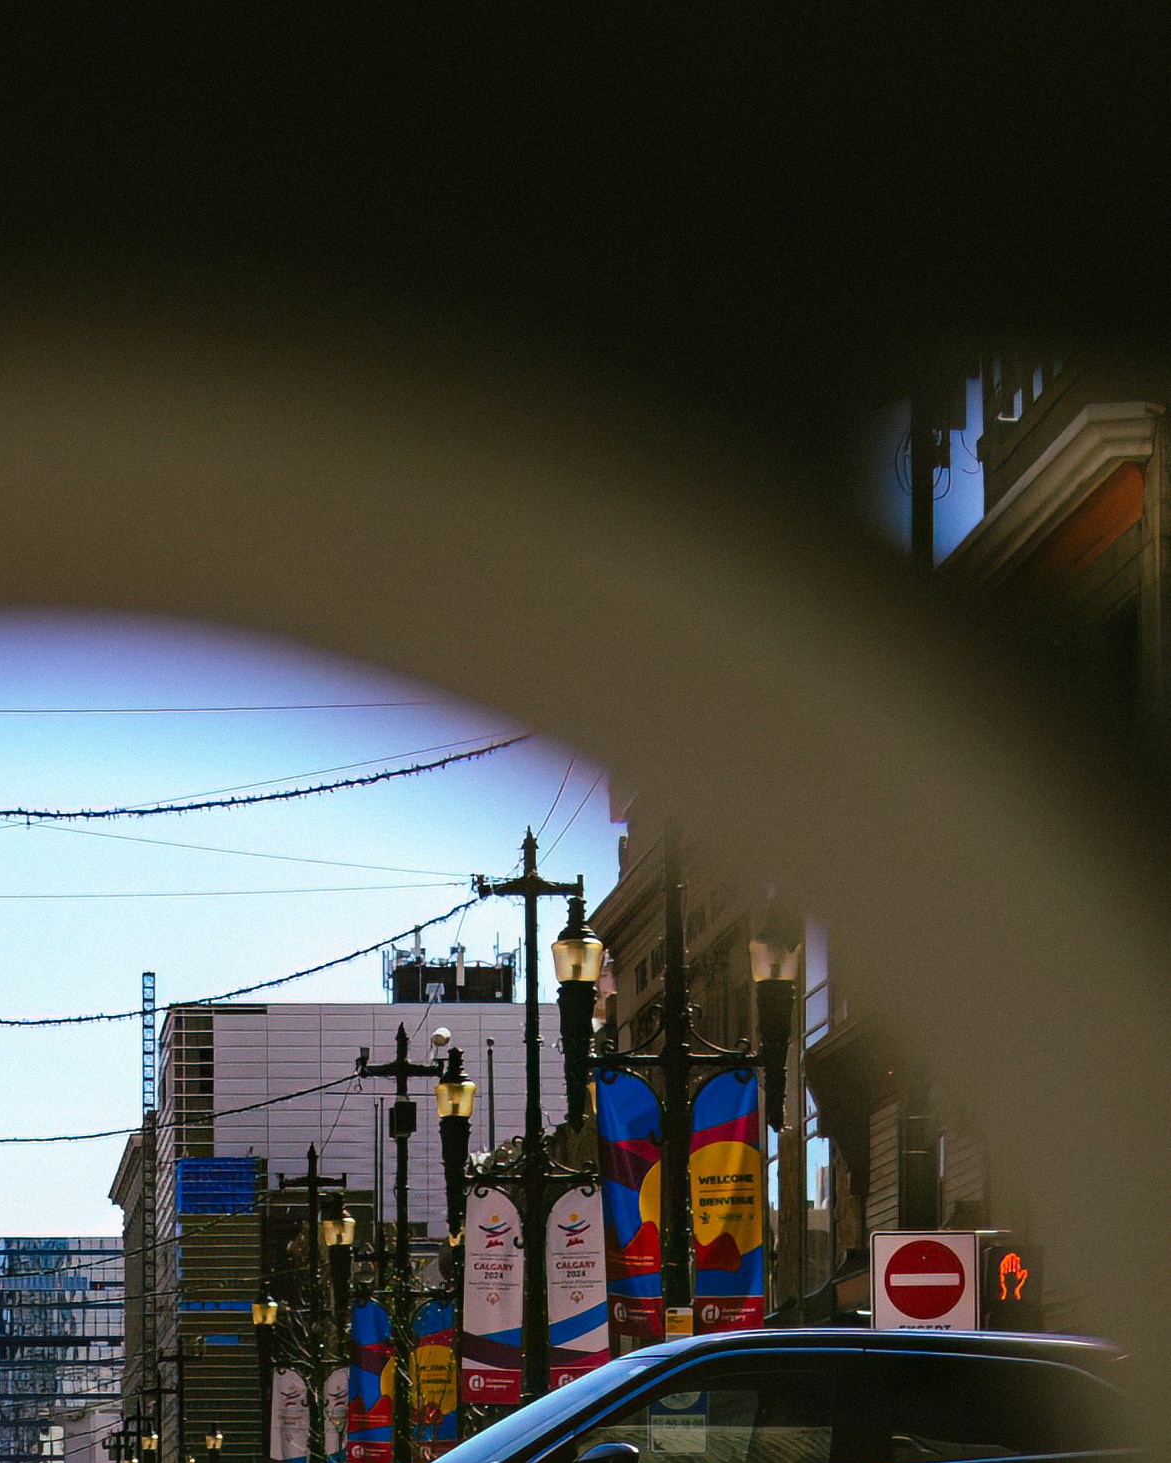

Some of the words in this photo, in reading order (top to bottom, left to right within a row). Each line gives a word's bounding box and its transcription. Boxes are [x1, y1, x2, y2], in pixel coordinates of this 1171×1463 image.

[698, 1173, 754, 1185] WELCOME
[699, 1195, 755, 1207] BIENVENUE
[473, 1262, 514, 1272] CALGARY
[555, 1261, 596, 1271] CALGARY
[483, 1271, 505, 1281] 2024
[565, 1270, 586, 1279] 2024
